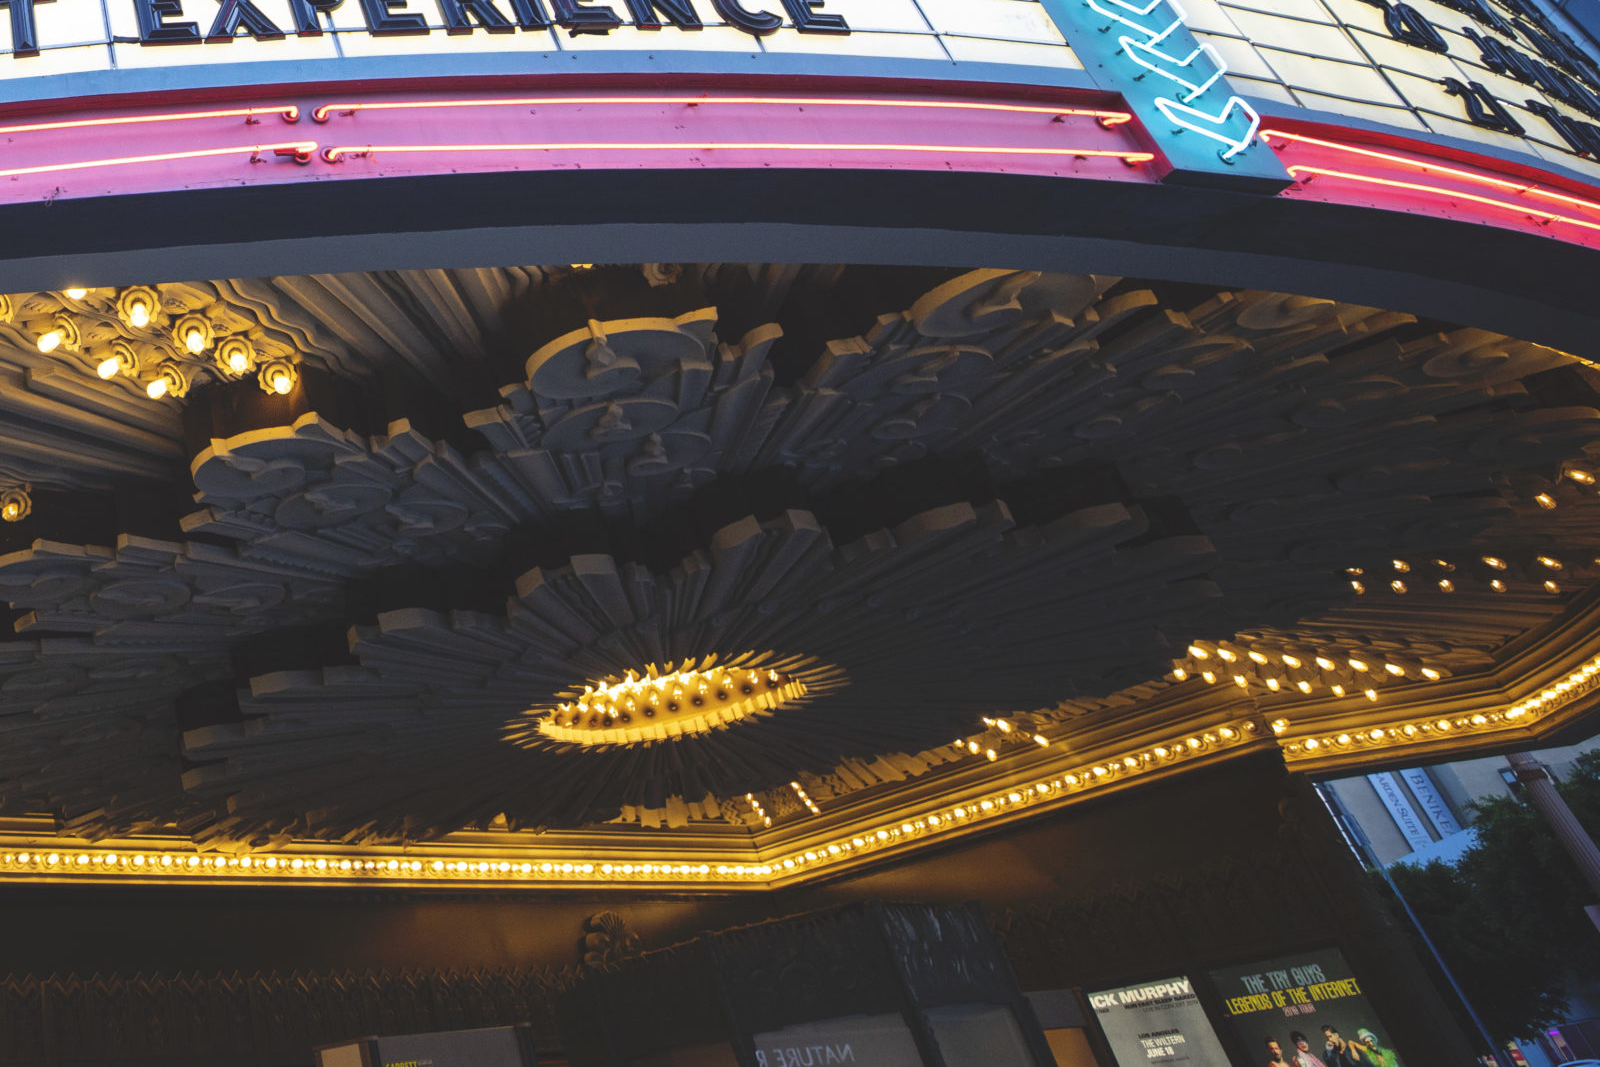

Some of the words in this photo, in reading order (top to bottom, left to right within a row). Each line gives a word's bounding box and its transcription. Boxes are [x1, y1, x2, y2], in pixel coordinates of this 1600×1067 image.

[1375, 772, 1401, 807] ARDEN
[1397, 806, 1421, 836] SUITE
[1240, 973, 1268, 994] THE
[1266, 969, 1292, 990] TRY
[1290, 964, 1327, 987] GUYS
[1089, 993, 1119, 1010] ICK
[1118, 980, 1190, 1004] MURPHY
[1225, 992, 1273, 1015] LEGENDS
[1270, 990, 1287, 1008] OF
[1285, 986, 1311, 1005] THE
[1307, 977, 1362, 1002] INTERNET
[1140, 1039, 1156, 1049] THE
[1155, 1035, 1186, 1047] WILTERN
[1146, 1047, 1166, 1059] JUNE
